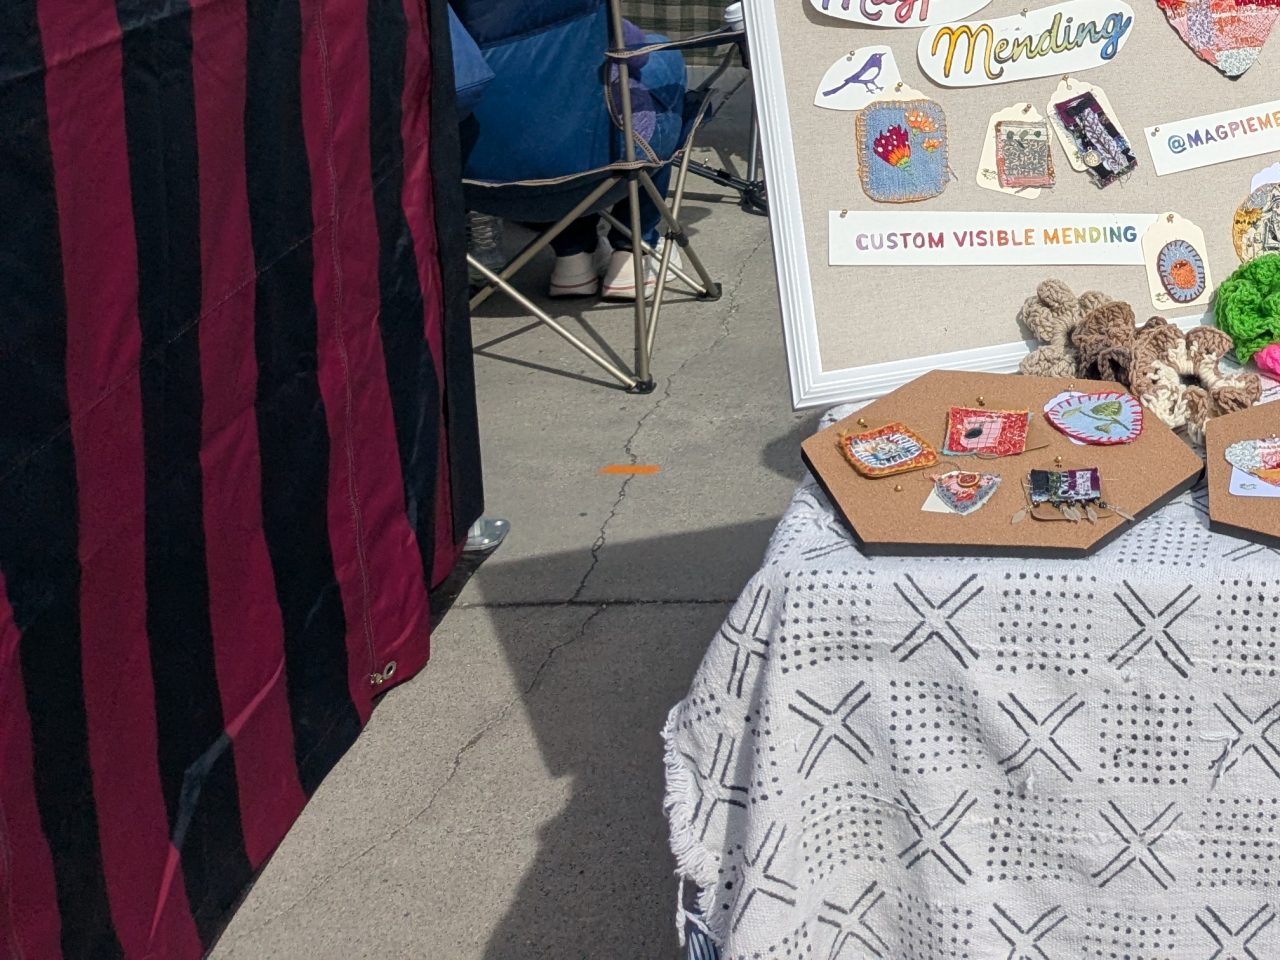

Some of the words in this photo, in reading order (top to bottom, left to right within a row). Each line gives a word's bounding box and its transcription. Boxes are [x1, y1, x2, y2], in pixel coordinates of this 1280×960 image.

[931, 10, 1133, 80] Mending
[855, 231, 945, 251] CUSTOM
[953, 228, 1036, 248] VISIBLE
[1043, 225, 1138, 245] MENDING
